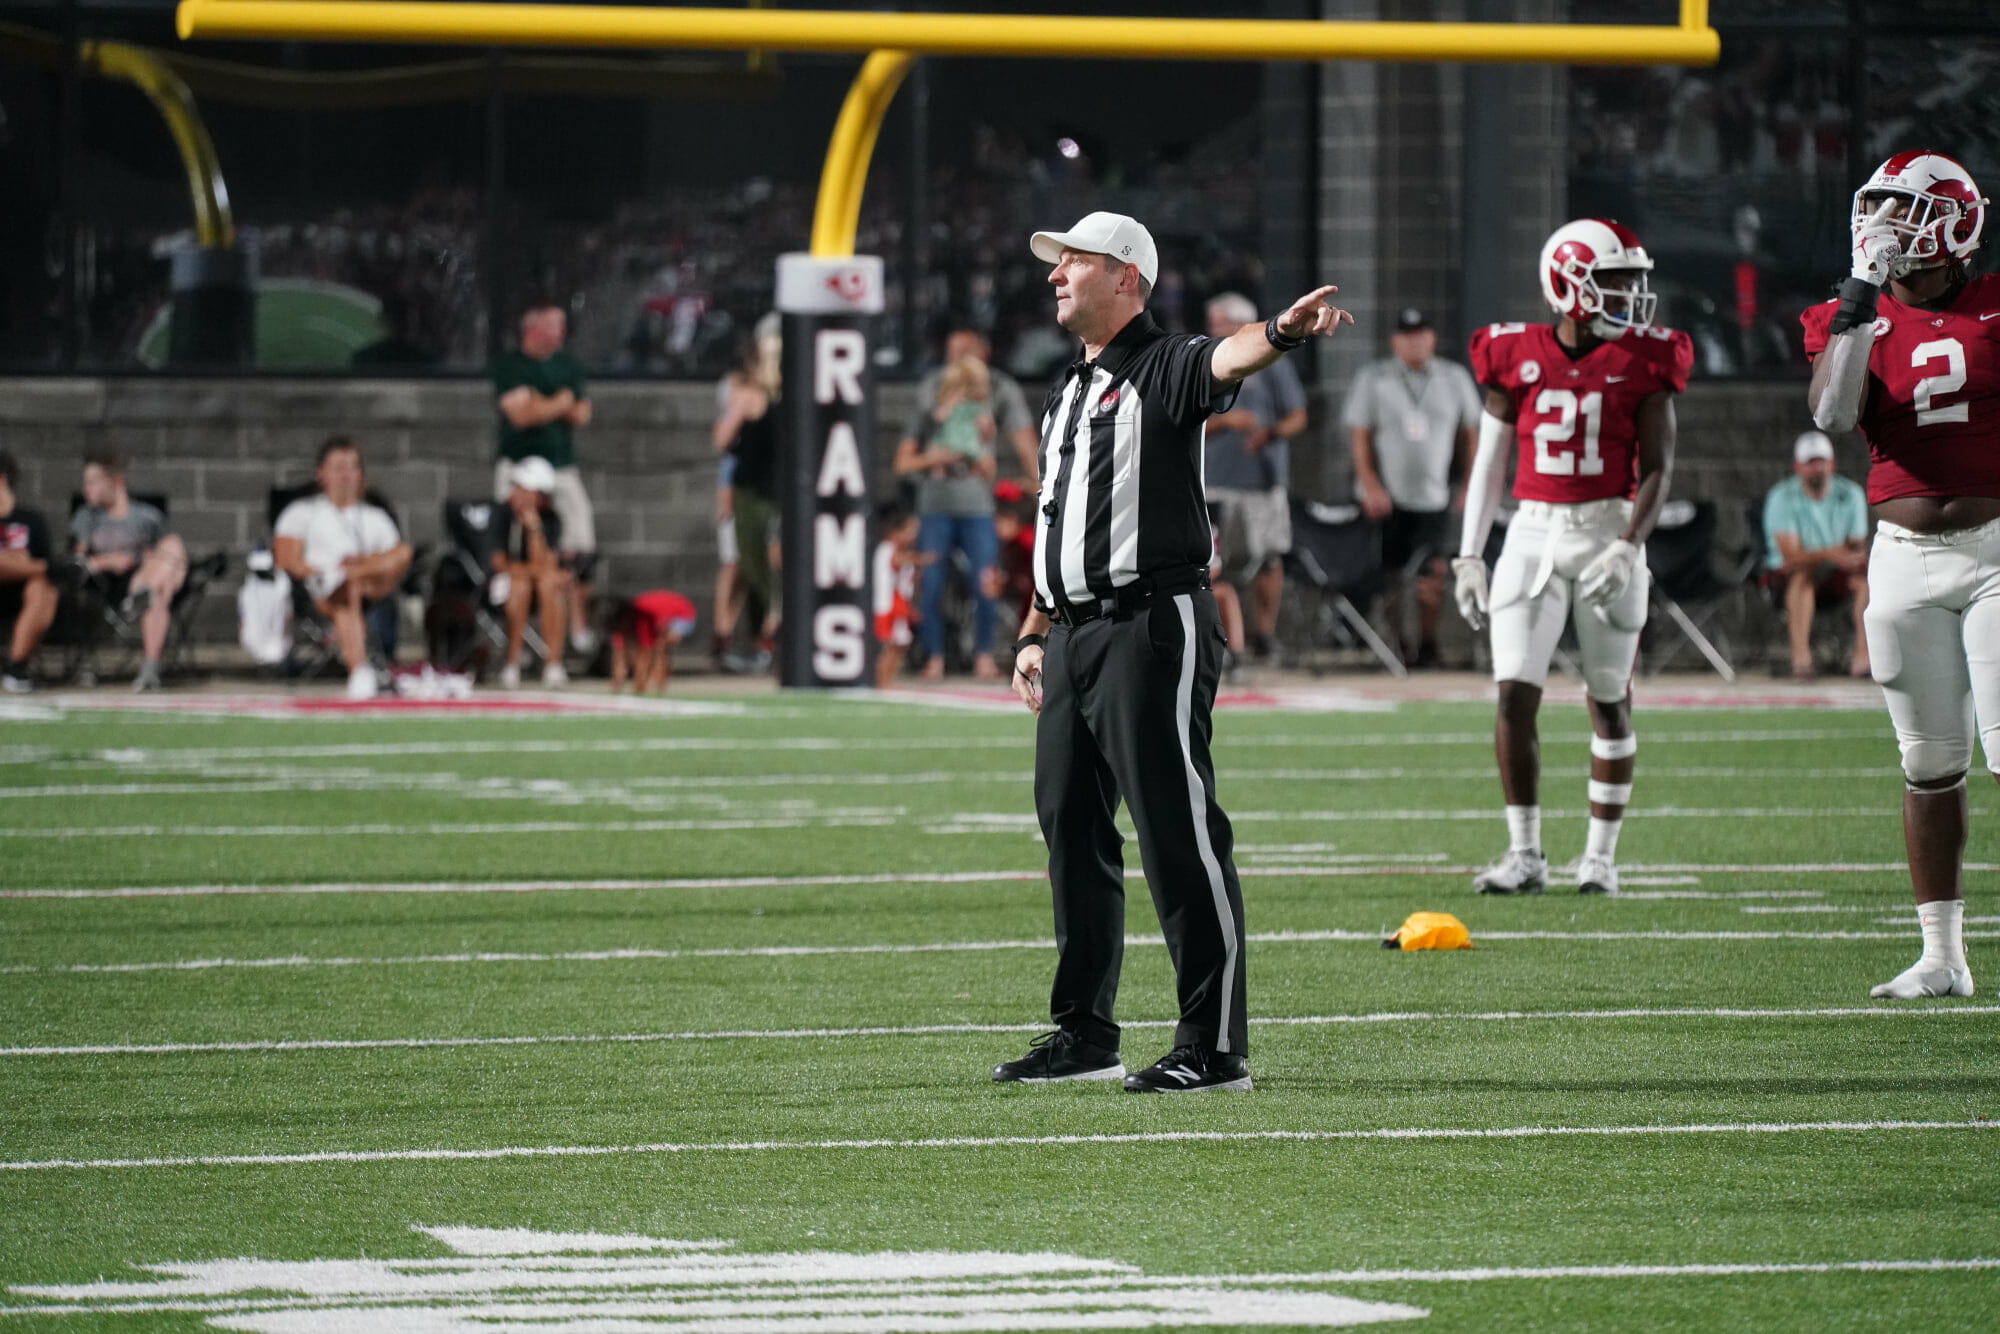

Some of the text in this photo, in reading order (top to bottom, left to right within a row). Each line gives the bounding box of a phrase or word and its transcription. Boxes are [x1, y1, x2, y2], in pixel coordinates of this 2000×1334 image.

[1911, 337, 1969, 427] 2
[1533, 389, 1604, 476] 21
[814, 329, 866, 679] RAMS
